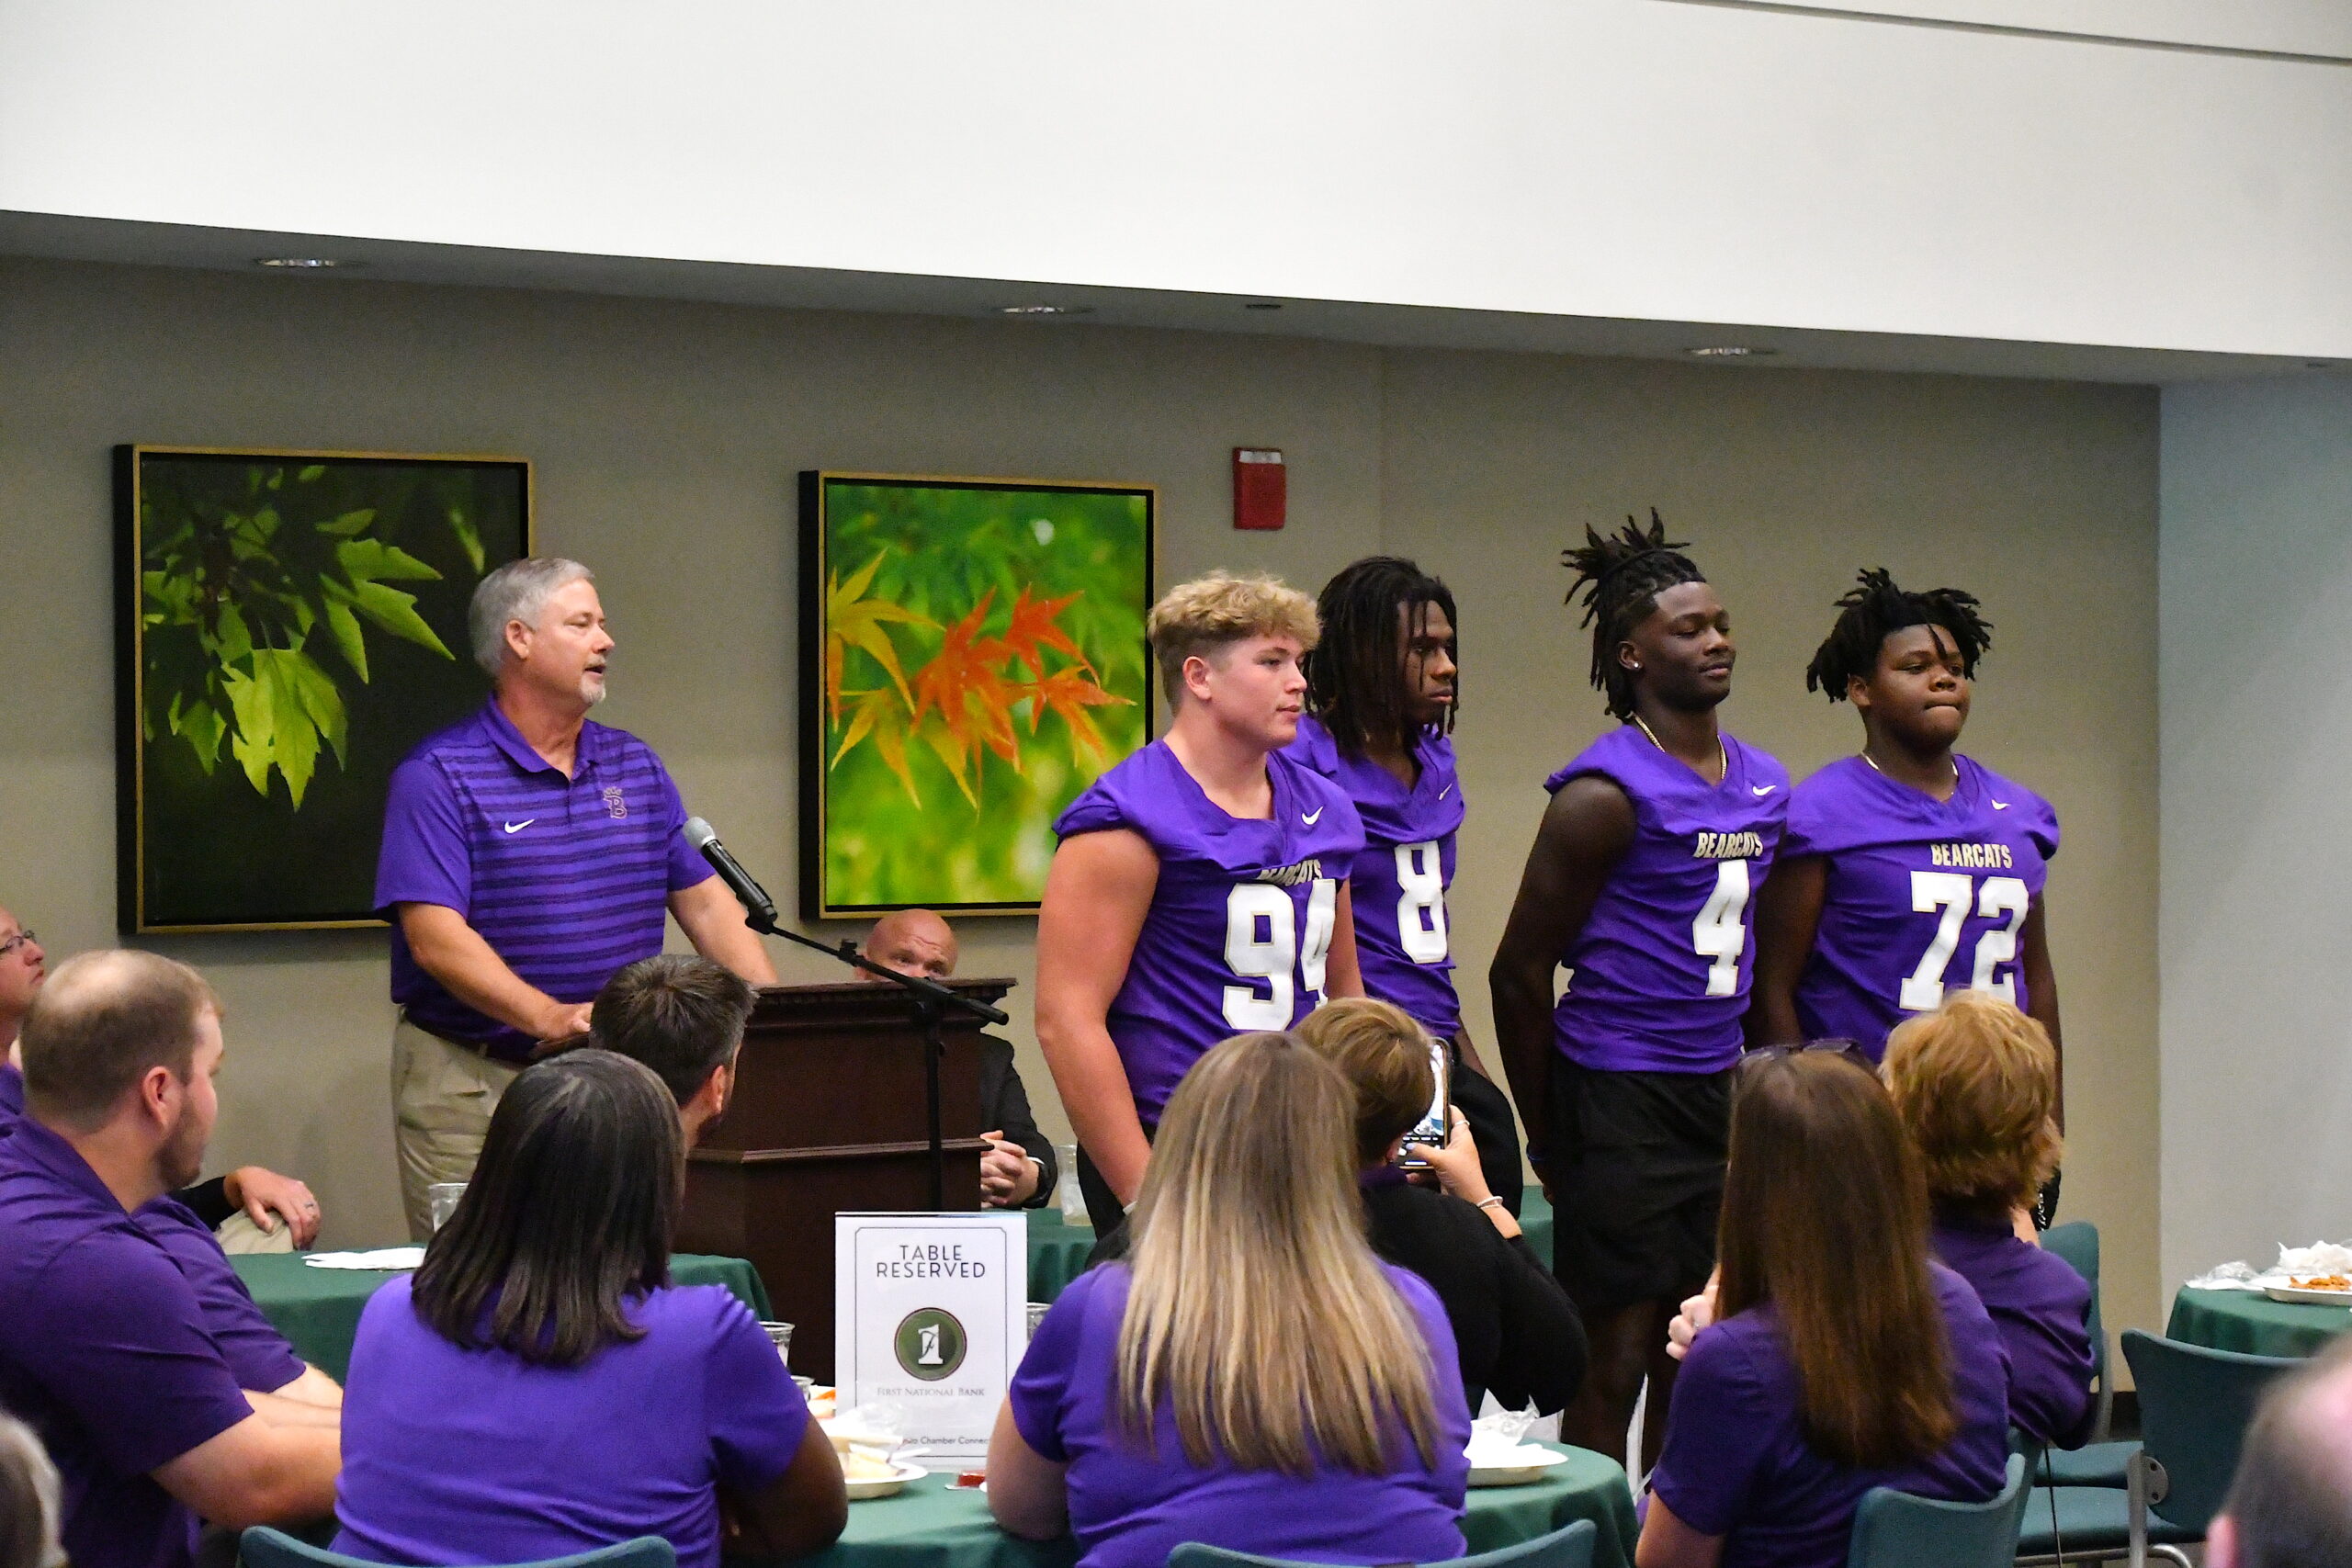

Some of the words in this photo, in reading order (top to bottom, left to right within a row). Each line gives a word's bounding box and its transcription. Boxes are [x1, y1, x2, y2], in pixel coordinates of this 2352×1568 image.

[1692, 831, 1763, 858] BEARCATS
[1930, 843, 2013, 868] BEARCATS
[1395, 840, 1448, 964] 8
[1692, 859, 1750, 996] 4
[1899, 871, 2029, 1010] 72
[1222, 878, 1336, 1032] 94
[899, 1245, 962, 1260] TABLE
[876, 1262, 986, 1278] RESERVED
[905, 1387, 953, 1396] NATIONAL
[958, 1387, 985, 1396] BANK
[920, 1437, 956, 1445] Chamber
[958, 1437, 989, 1445] Connec
